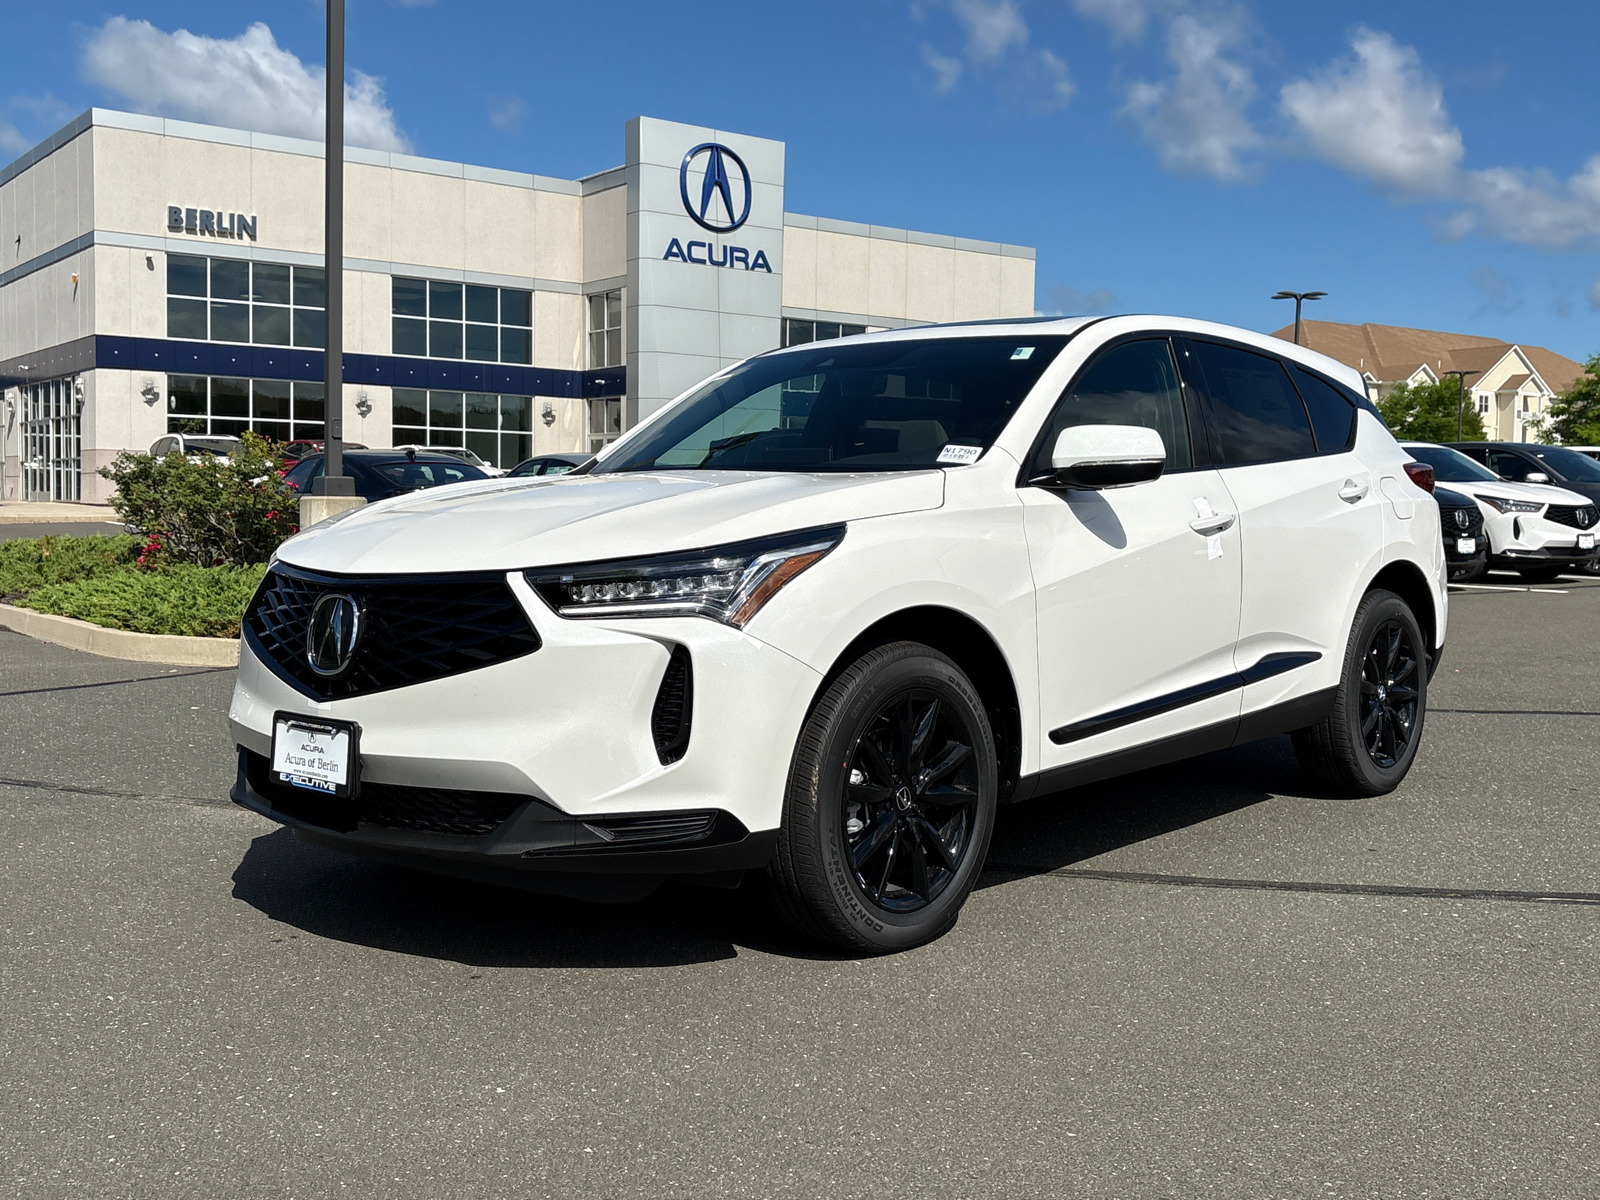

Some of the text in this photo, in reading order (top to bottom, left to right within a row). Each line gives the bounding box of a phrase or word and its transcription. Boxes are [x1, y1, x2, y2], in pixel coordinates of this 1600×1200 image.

[168, 205, 257, 242] BERLIN
[662, 237, 772, 273] ACURA
[943, 447, 978, 455] N1790
[300, 743, 325, 755] ACURA
[284, 751, 339, 773] Acura of Berlin
[280, 773, 336, 791] EXECUTIVE
[828, 819, 885, 933] CONTINENTAL
